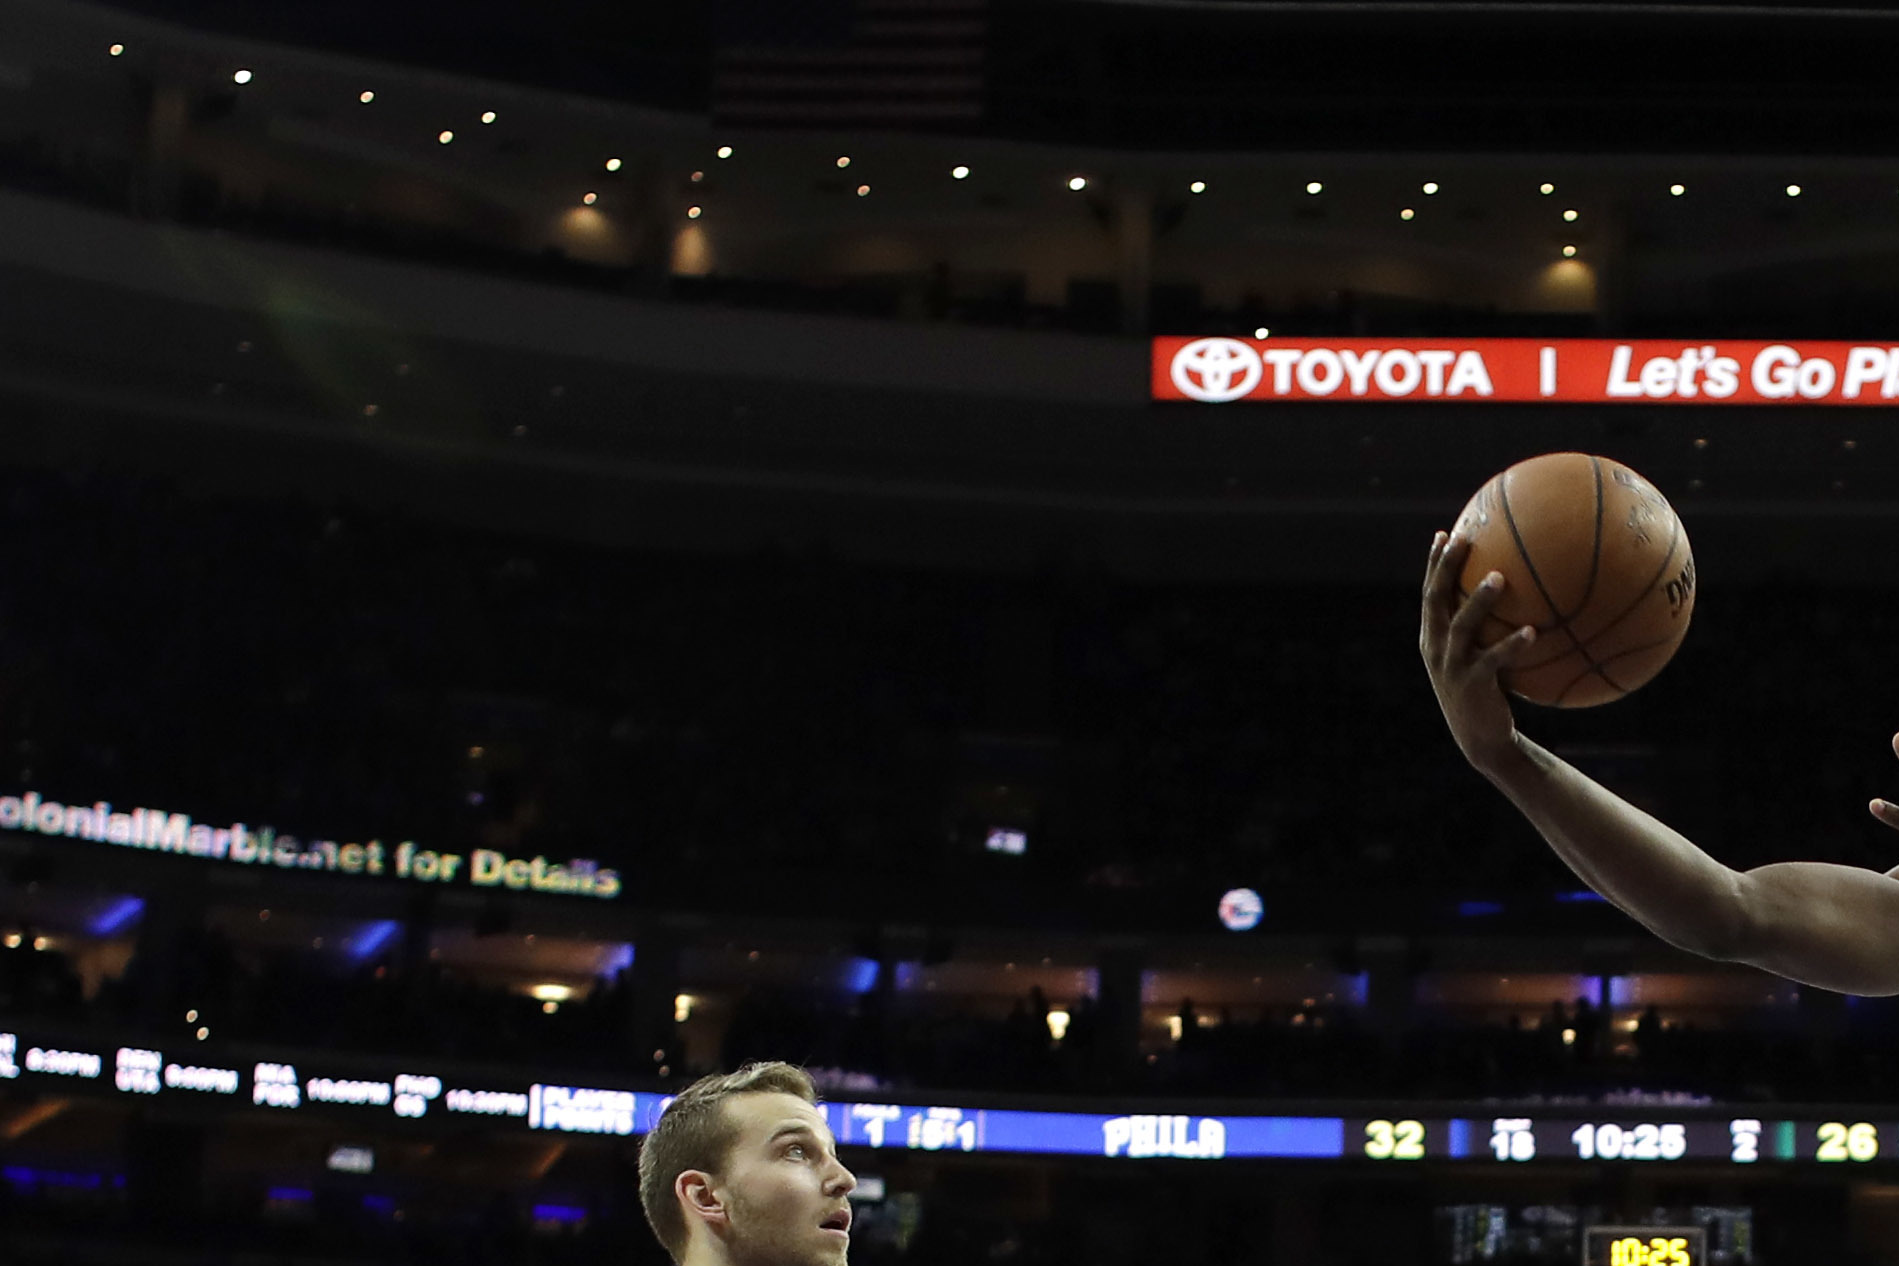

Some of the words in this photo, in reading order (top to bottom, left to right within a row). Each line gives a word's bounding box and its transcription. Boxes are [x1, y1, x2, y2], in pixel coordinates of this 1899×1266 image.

[1264, 348, 1493, 395] TOYOTA
[1607, 345, 1739, 398] Let's
[1750, 344, 1836, 399] Go
[394, 840, 462, 883] for
[469, 847, 622, 899] Details
[1103, 1115, 1226, 1159] PHILA
[1364, 1120, 1426, 1159] 32
[1571, 1123, 1687, 1160] 10:25
[1730, 1131, 1759, 1163] 2
[1815, 1122, 1879, 1162] 26
